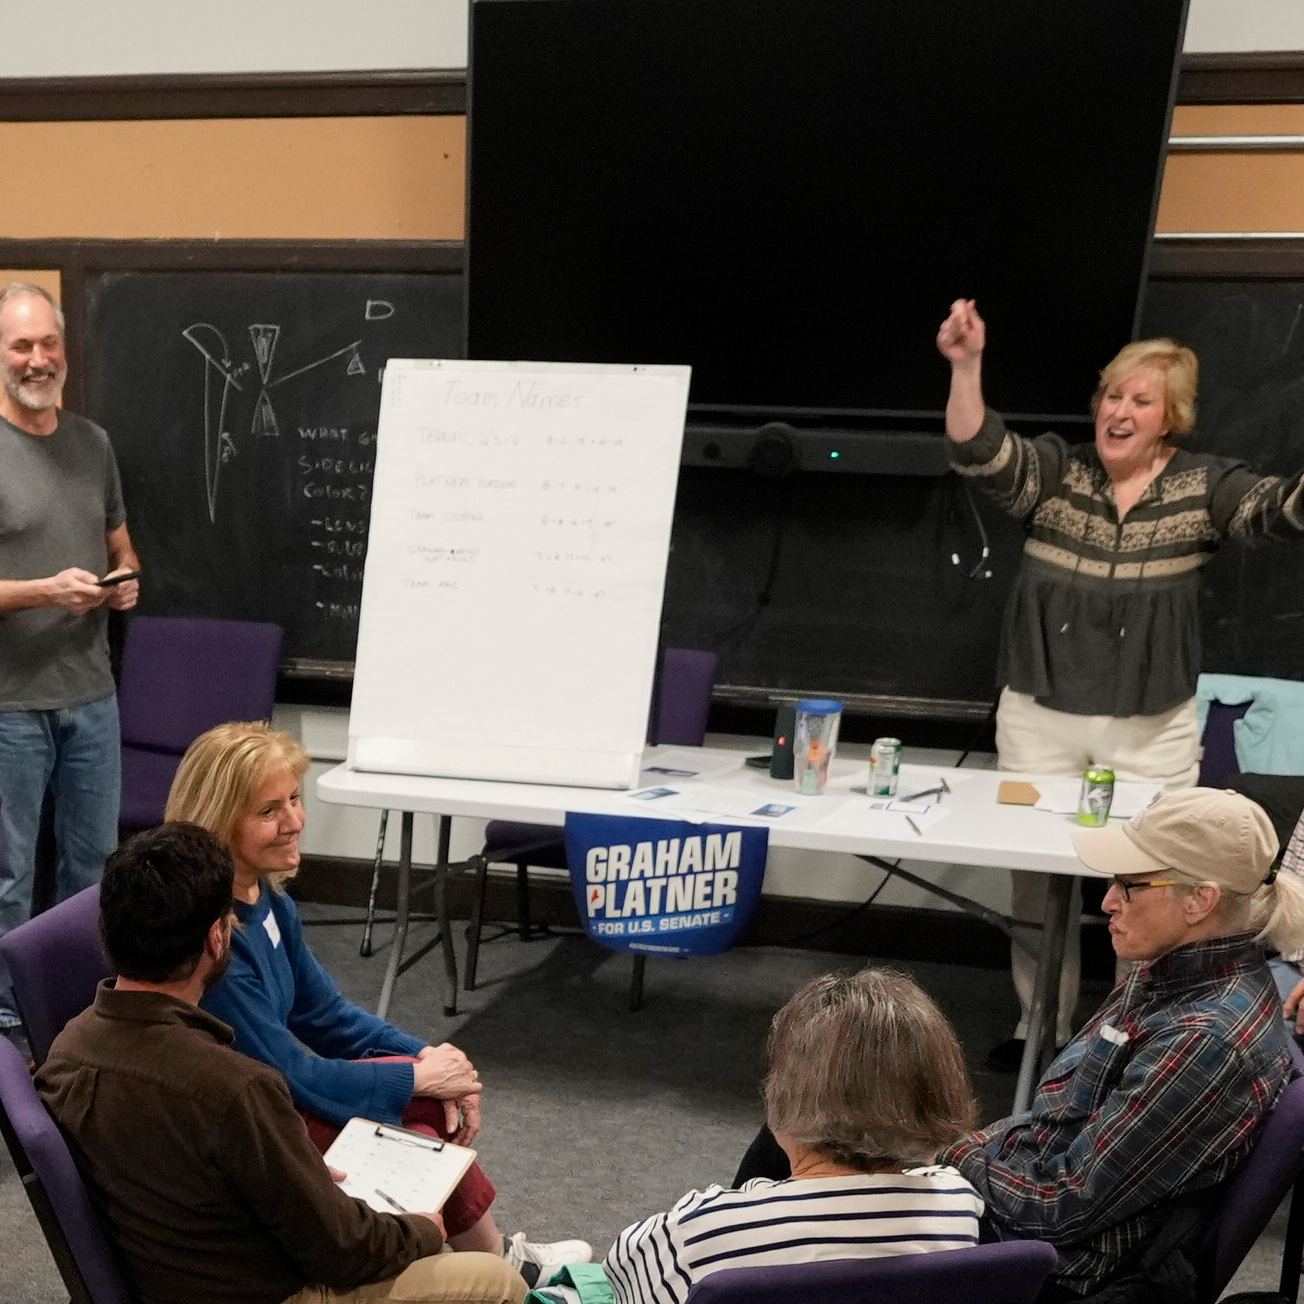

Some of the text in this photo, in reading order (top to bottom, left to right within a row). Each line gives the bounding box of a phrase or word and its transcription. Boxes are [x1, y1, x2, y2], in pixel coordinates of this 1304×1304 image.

[443, 379, 585, 410] Team Names
[586, 831, 742, 883] GRAHAM
[586, 870, 739, 918] PLATNER
[598, 912, 721, 935] FOR U.S. SENATE
